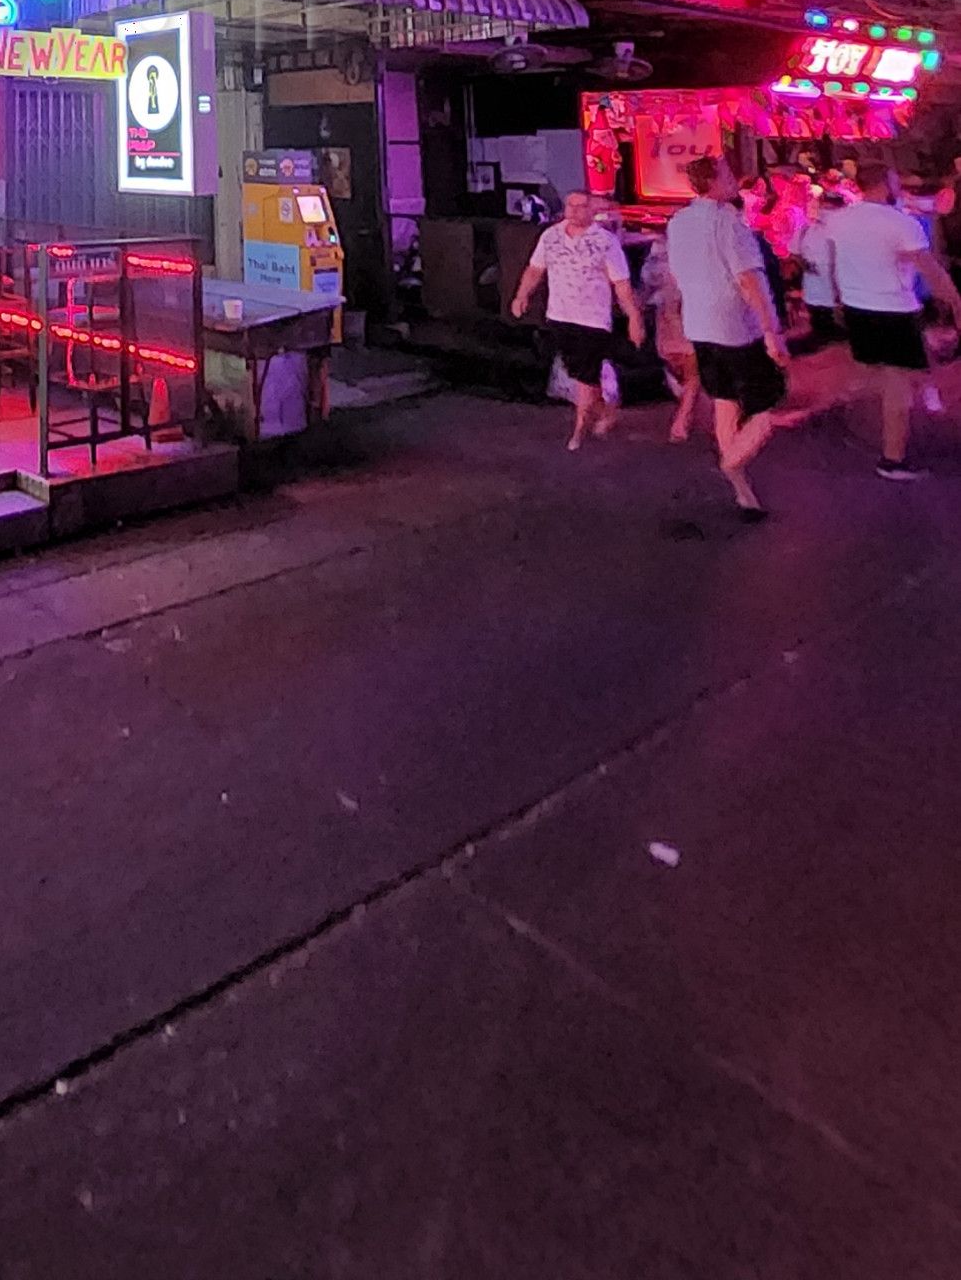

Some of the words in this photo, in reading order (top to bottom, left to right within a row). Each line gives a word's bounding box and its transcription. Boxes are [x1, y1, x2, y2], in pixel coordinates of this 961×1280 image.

[58, 32, 127, 75] YEAR
[248, 257, 269, 270] Thai
[271, 261, 296, 275] Baht
